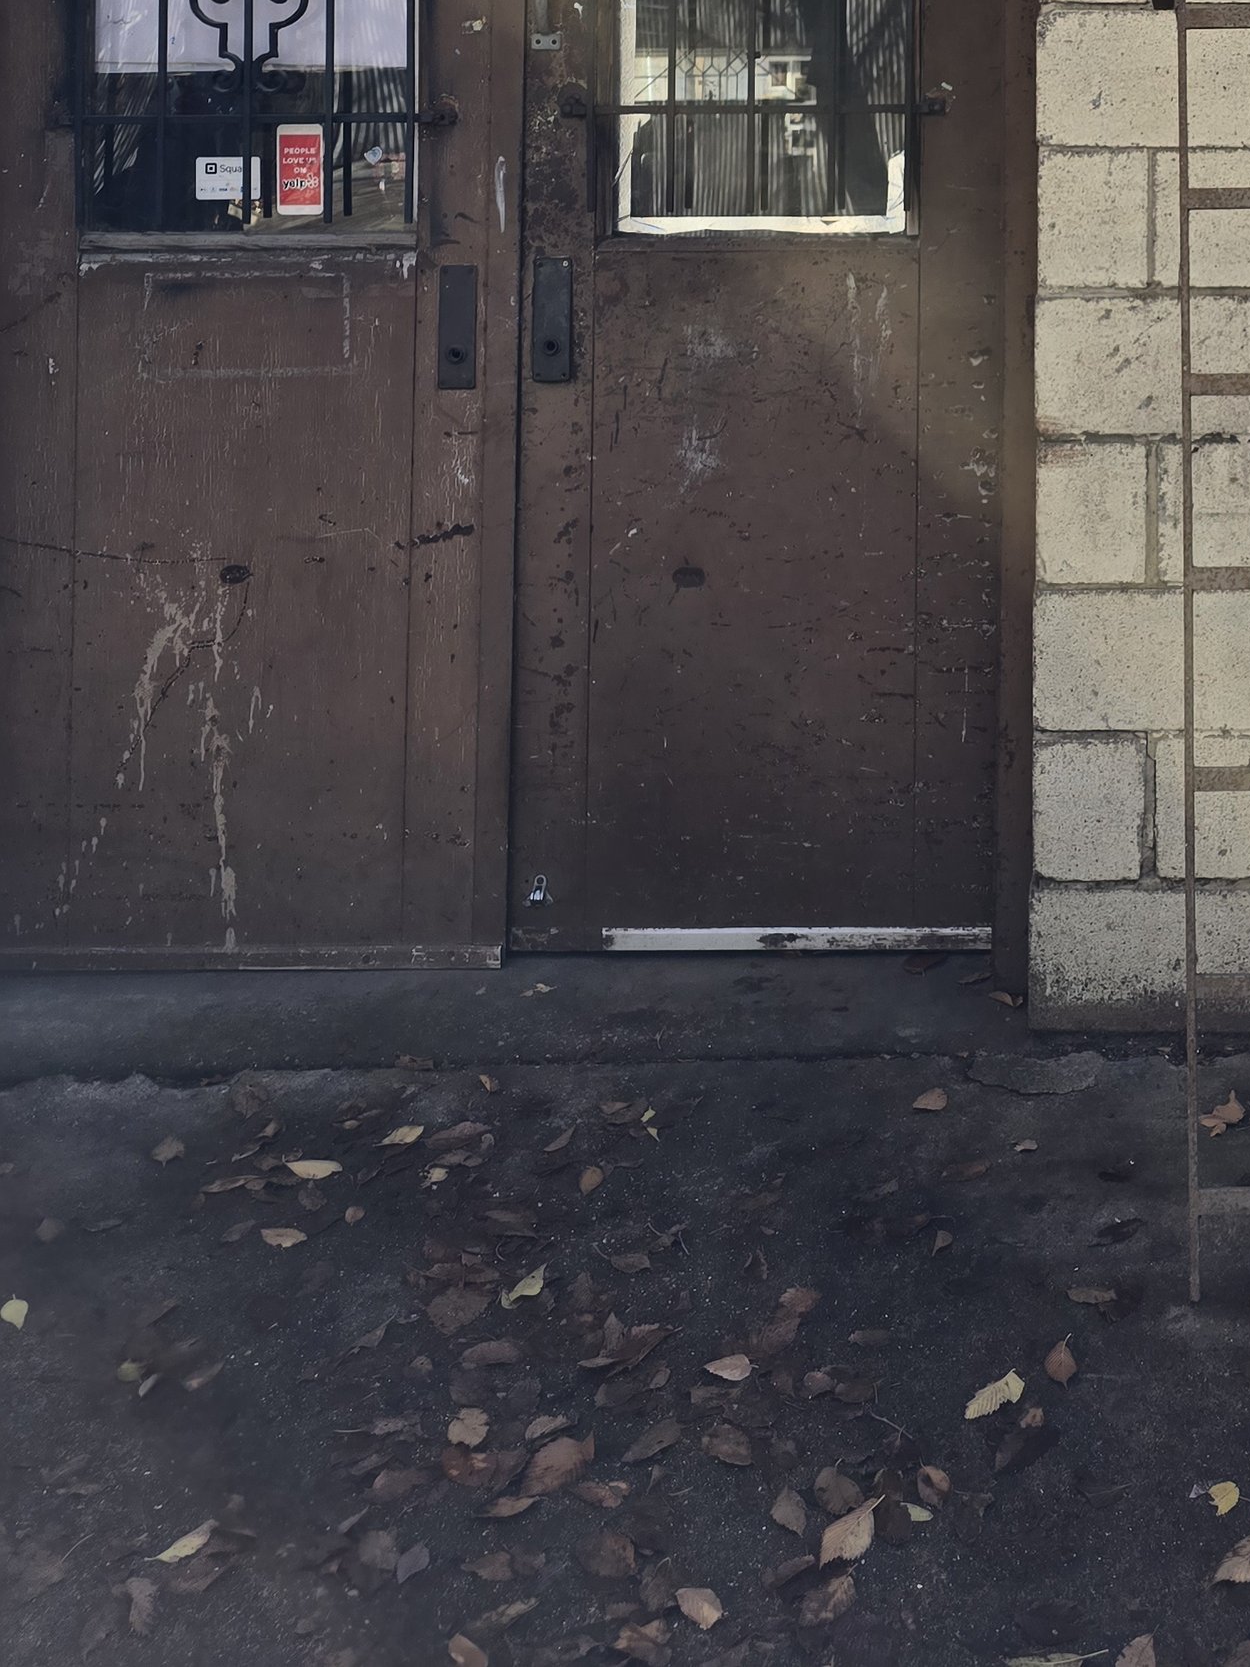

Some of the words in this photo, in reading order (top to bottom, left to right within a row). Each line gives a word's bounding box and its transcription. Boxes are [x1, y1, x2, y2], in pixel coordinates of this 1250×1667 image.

[283, 147, 316, 155] PEOPLE
[219, 164, 243, 174] Squa
[282, 178, 307, 191] yelp
